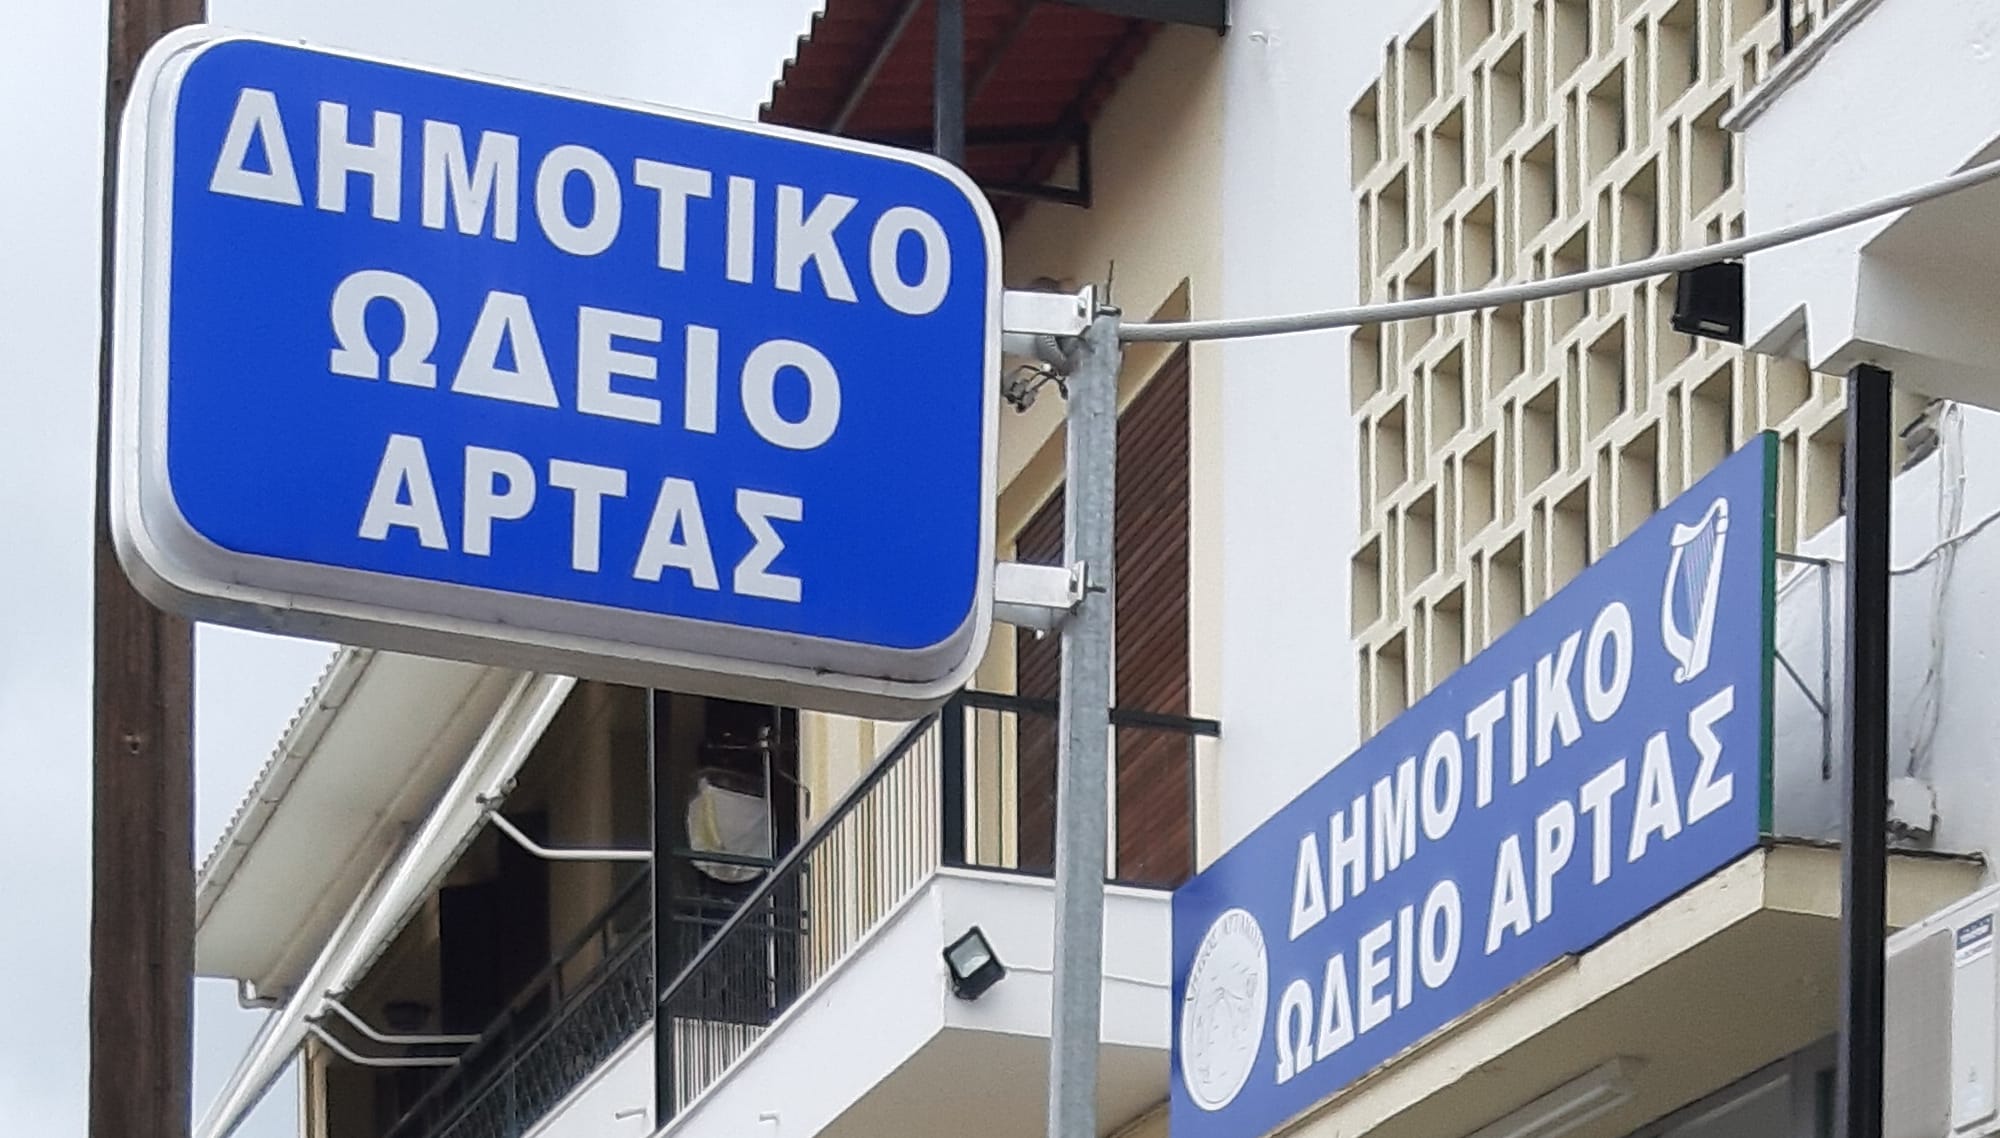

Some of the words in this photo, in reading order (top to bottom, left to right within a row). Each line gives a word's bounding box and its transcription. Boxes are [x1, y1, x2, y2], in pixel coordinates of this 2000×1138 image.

[209, 87, 951, 315] ΔΗΜΟΤΙΚΟ
[330, 269, 841, 450] ΩΔΕΙΟ
[358, 433, 803, 603] ΑΡΤΑΣ
[1276, 878, 1463, 1085] ΩΔΕΙΟ
[1484, 684, 1735, 956] ΑΡΤΑΣ
[1289, 601, 1634, 942] ΔΗΜΟΤΙΚΟ
